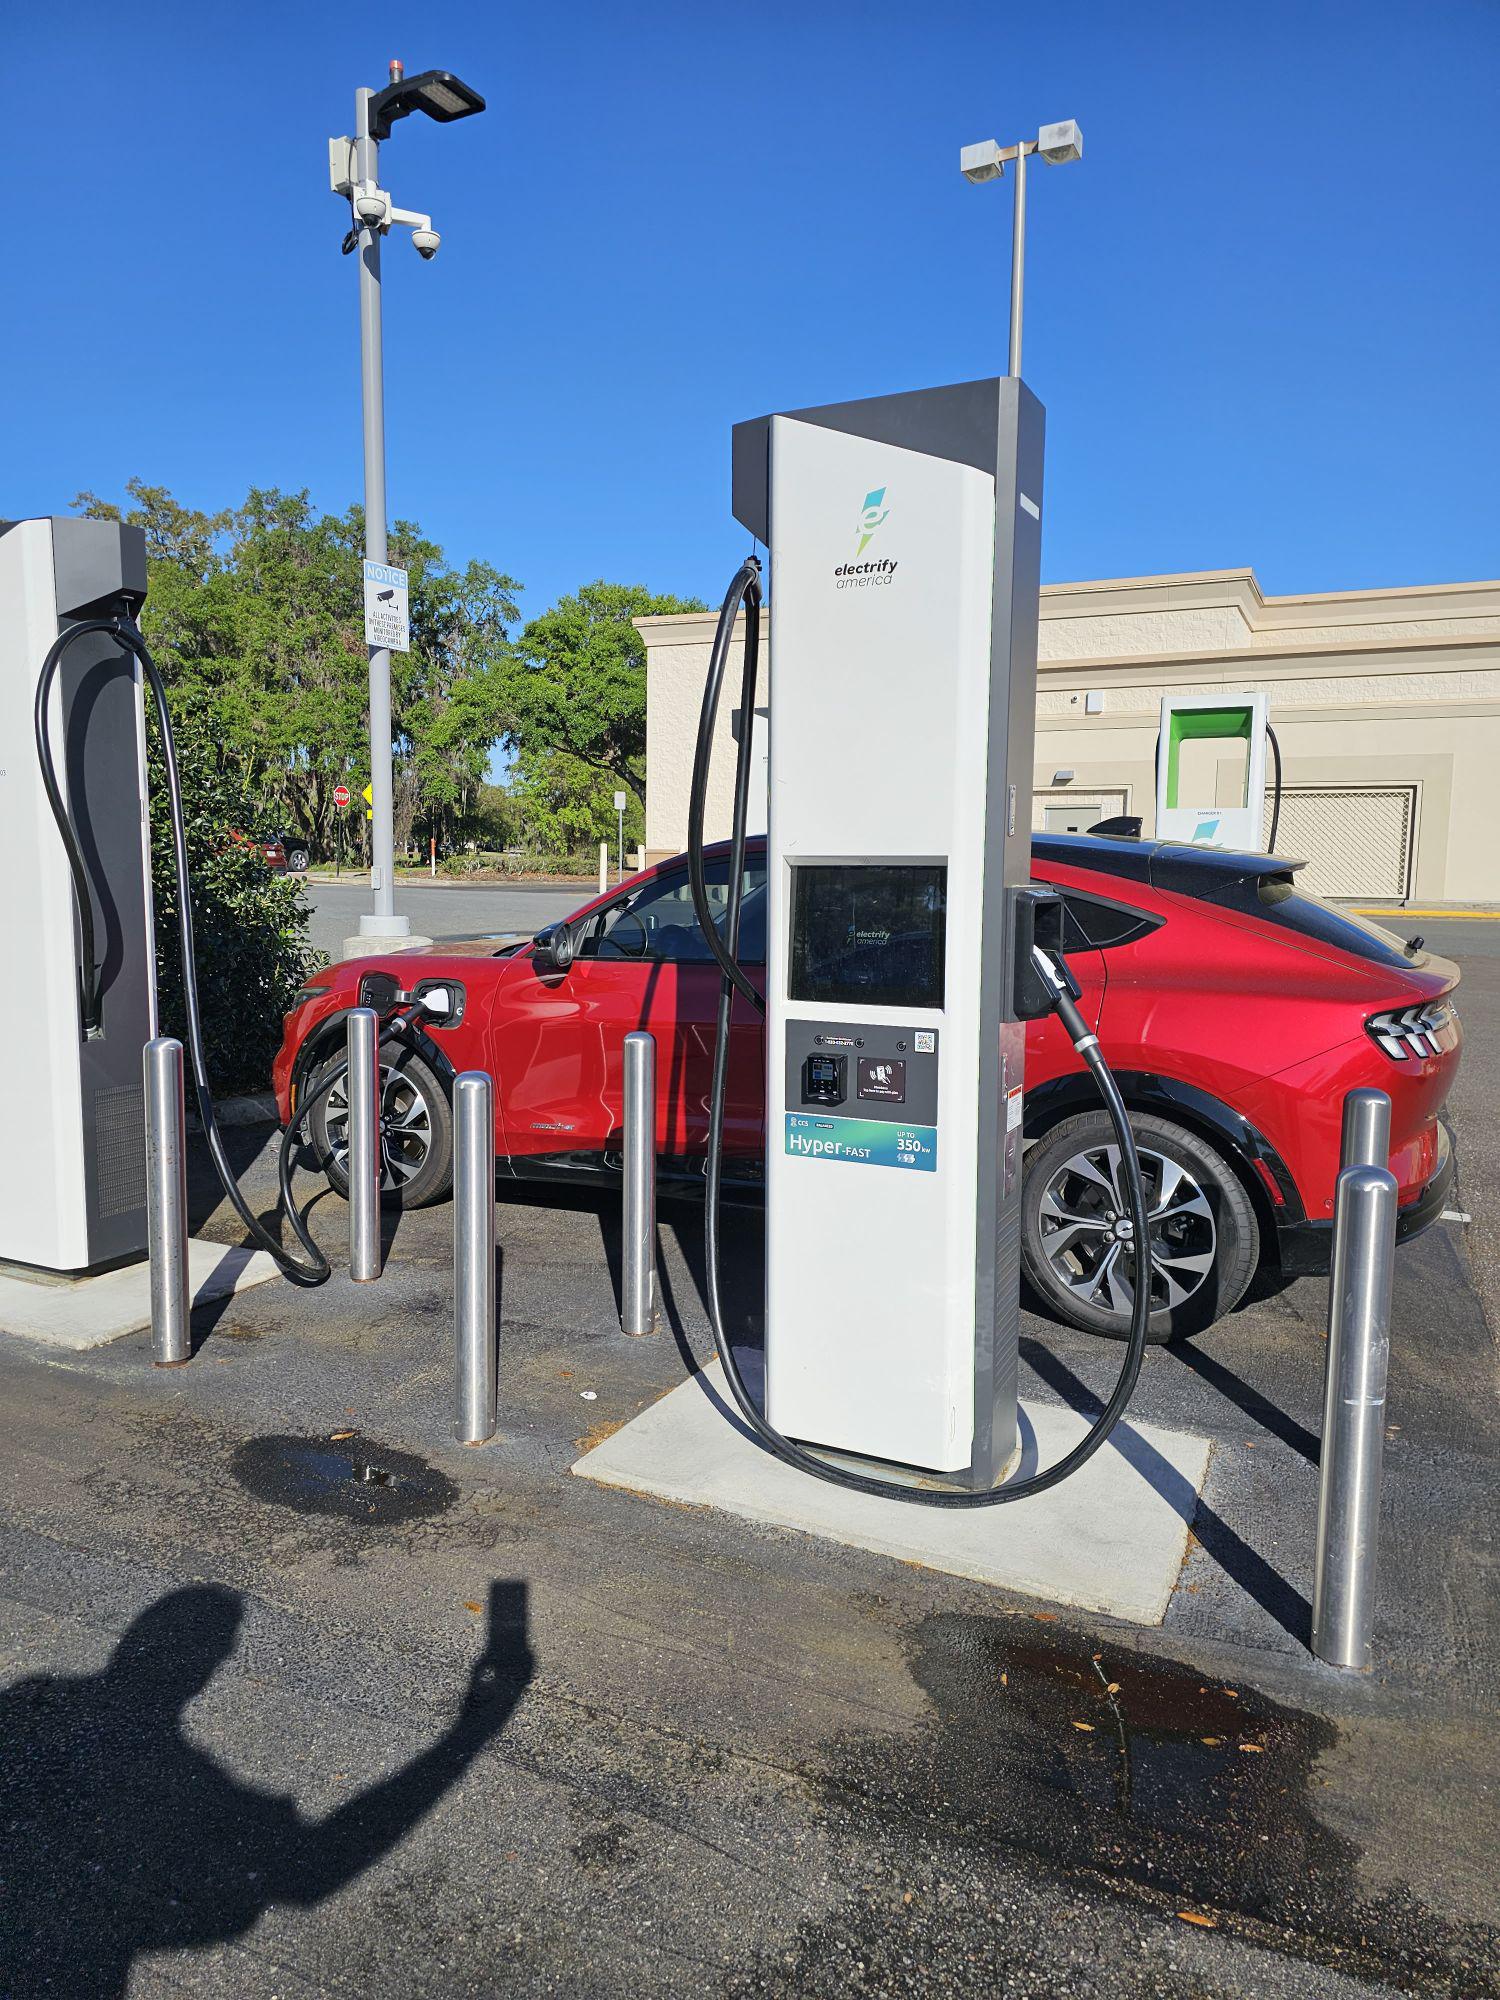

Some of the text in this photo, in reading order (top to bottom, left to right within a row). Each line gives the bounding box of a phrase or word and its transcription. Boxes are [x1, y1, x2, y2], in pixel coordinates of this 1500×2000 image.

[834, 558, 898, 576] electrify
[367, 565, 405, 586] NOTICE
[836, 574, 893, 589] america
[335, 792, 349, 801] STOP
[857, 930, 891, 940] electrify
[897, 1139, 921, 1151] 350
